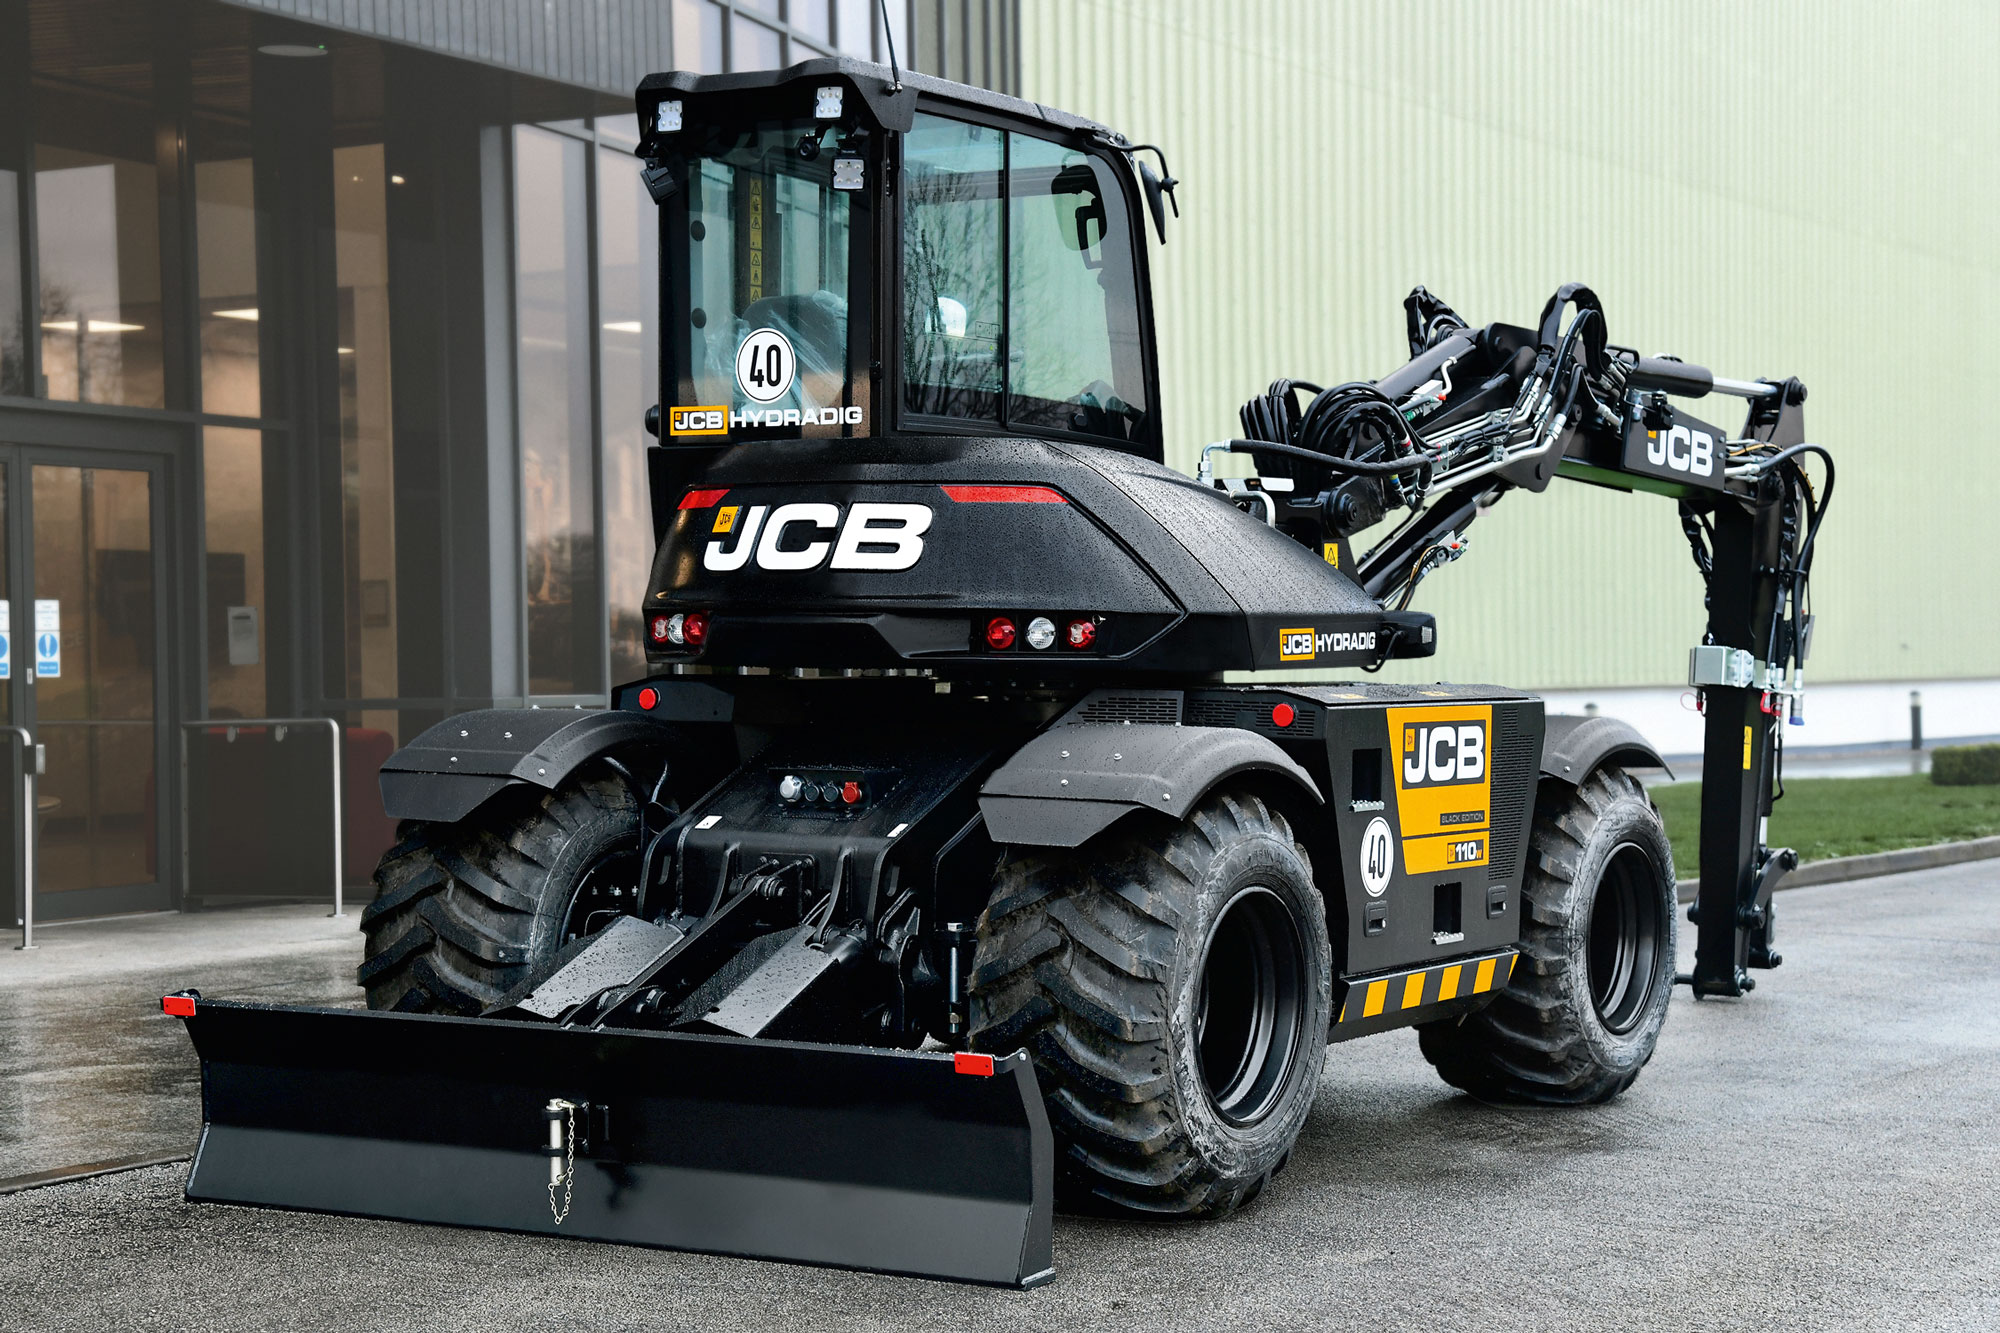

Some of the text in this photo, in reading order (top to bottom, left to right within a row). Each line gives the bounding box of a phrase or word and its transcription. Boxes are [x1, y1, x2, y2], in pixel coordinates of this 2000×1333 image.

[749, 343, 782, 388] 40
[675, 406, 862, 430] JCB HYDRADIG
[1647, 424, 1713, 477] JCB
[704, 503, 933, 571] JCB
[1283, 631, 1376, 655] JCB HYDRADIG
[1404, 725, 1484, 784] JCB
[1442, 812, 1483, 823] BLACK EDITION
[1368, 834, 1386, 880] 40
